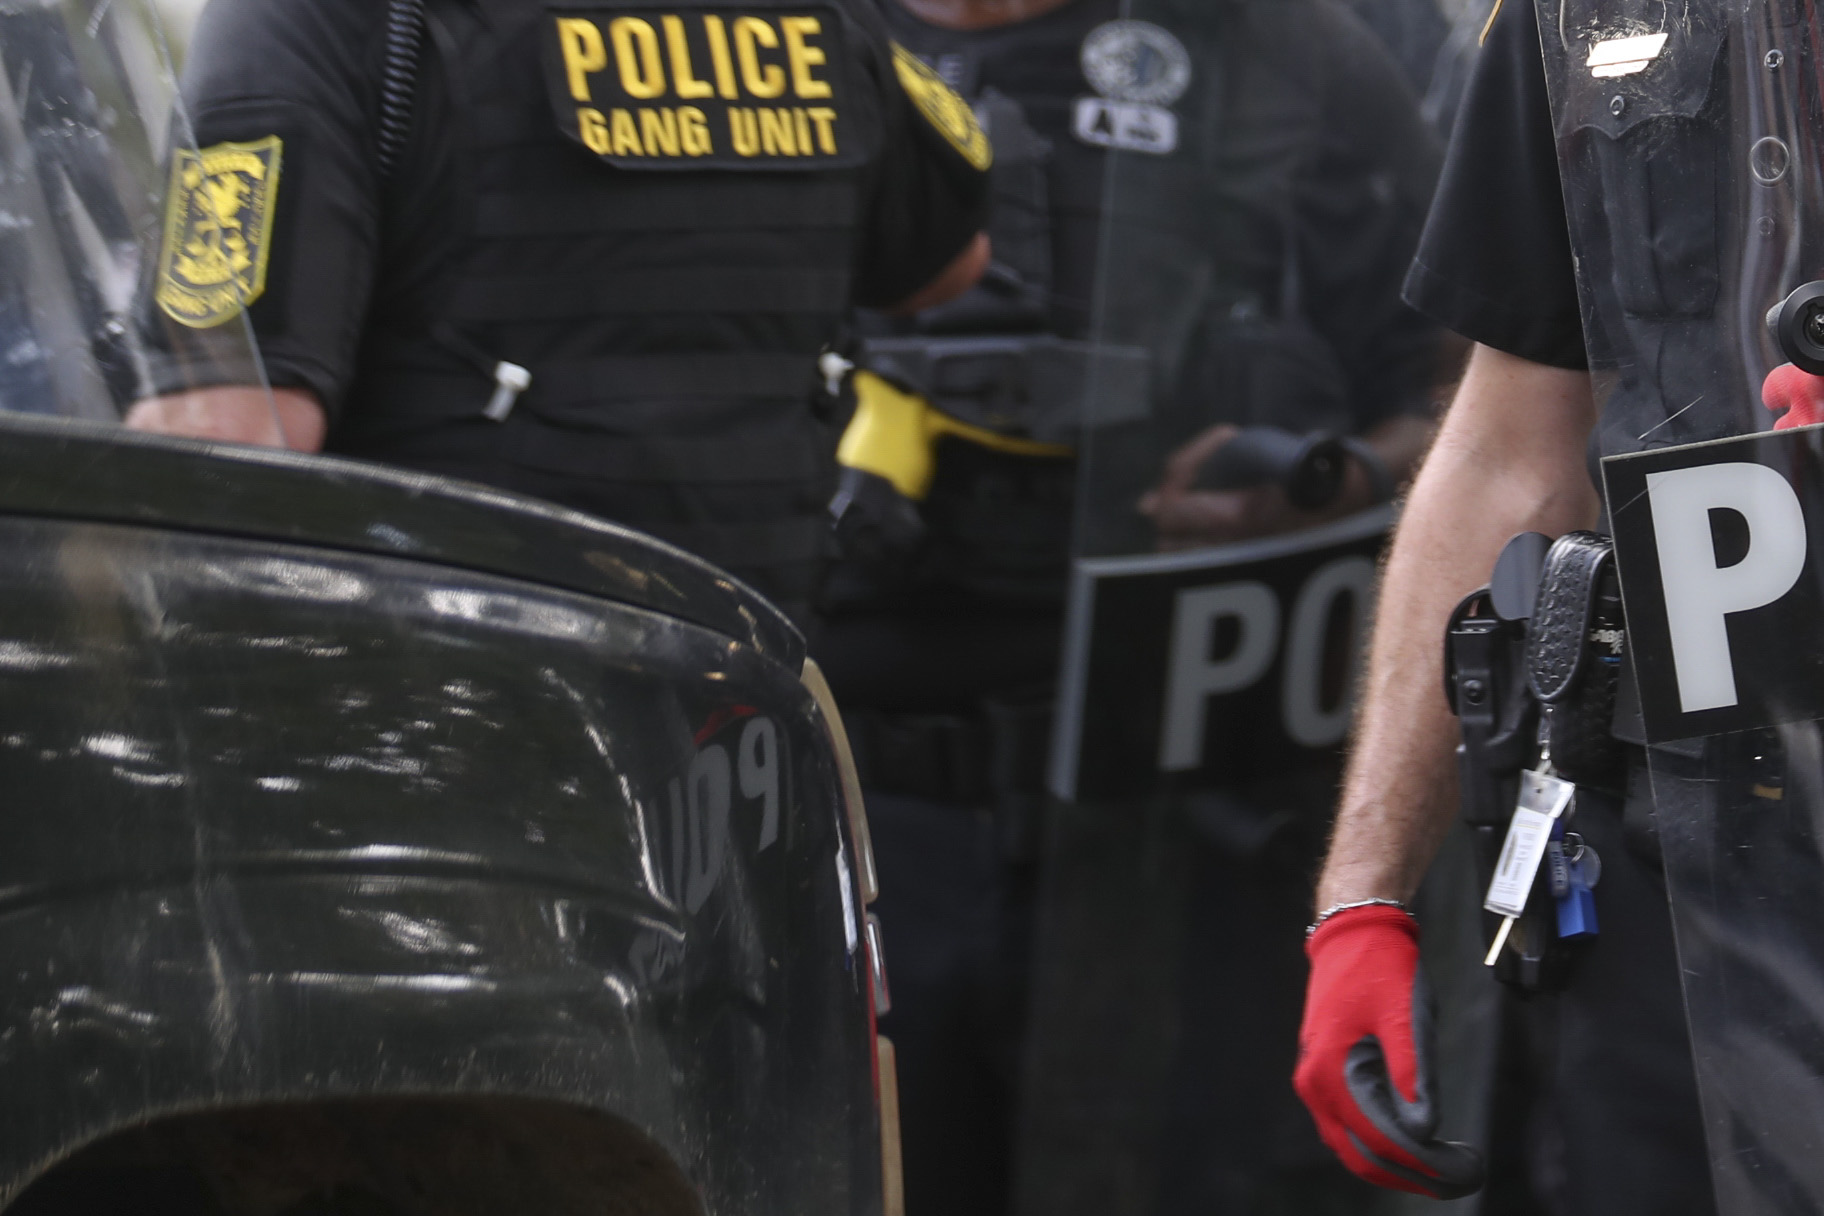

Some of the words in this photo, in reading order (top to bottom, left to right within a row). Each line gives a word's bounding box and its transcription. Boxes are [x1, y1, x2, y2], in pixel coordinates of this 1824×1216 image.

[556, 14, 832, 101] POLICE
[576, 105, 714, 157] GANG
[727, 106, 837, 157] UNIT
